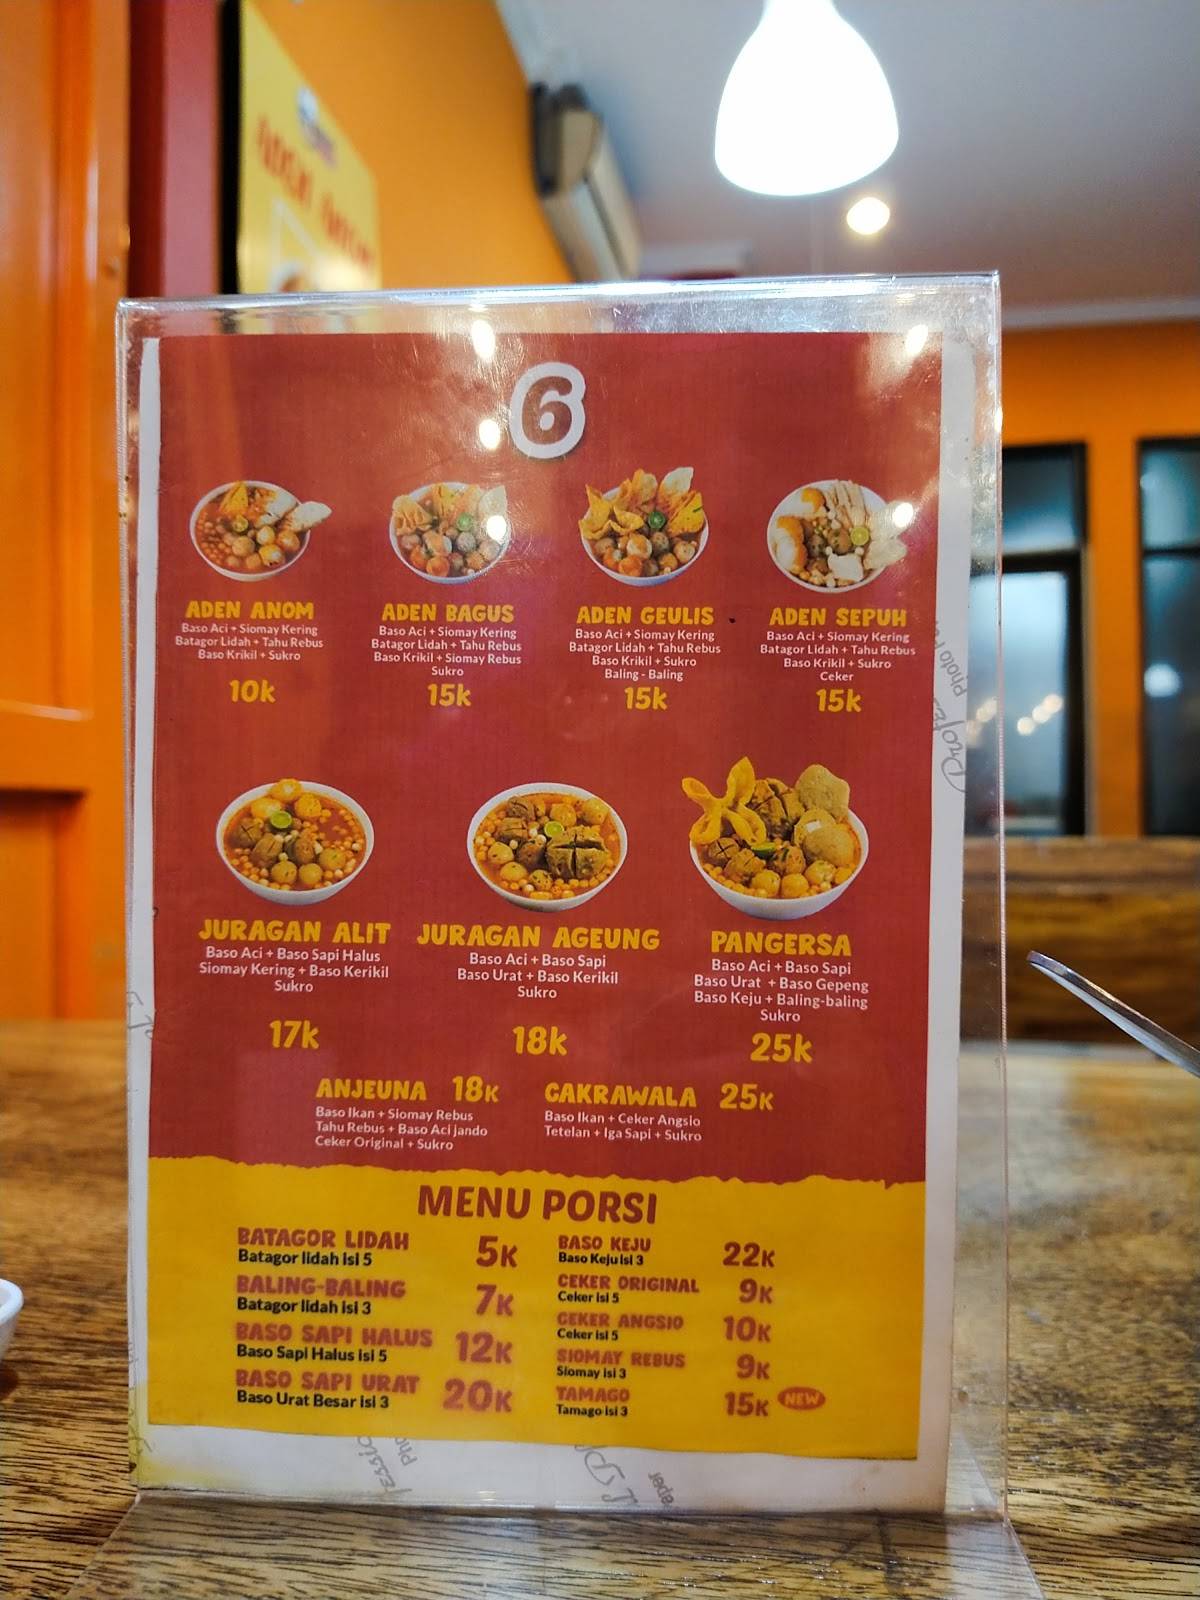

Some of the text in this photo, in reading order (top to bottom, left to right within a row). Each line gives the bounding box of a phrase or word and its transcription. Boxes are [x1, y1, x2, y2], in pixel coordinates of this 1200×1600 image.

[509, 362, 586, 459] 6
[185, 600, 314, 620] ADEN ANOM
[382, 603, 514, 623] ADEN BAGUS
[576, 606, 714, 625] ADEN GEULIS
[769, 607, 907, 627] ADEN SEPUH
[182, 623, 318, 636] Baso Aci Siomay Kering
[379, 626, 517, 639] Baso Aci Siomay Kering
[575, 629, 715, 642] Baso Aci Siomay Kering
[767, 631, 910, 644] Baso Aci Siomay Kering
[371, 639, 522, 651] Batagor Lidah Tahu Rebus
[374, 652, 522, 665] Baso Krikil Siomay Rebus
[592, 656, 697, 667] Baso Krikil Sukro
[431, 666, 464, 676] Sukro
[605, 669, 683, 681] Baling Baling
[820, 672, 854, 681] Ceker
[229, 679, 276, 703] 10k
[428, 683, 472, 707] 15k
[624, 686, 668, 710] 15k
[816, 688, 862, 712] 15k
[198, 919, 392, 944] JURAGAN ALIT
[417, 924, 660, 950] JURAGAN AGEUNG
[711, 931, 852, 956] PANGERSA
[206, 947, 381, 963] Baso Aci Baso Sapi Halus
[469, 953, 607, 970] Baso Aci Baso Sapi
[200, 963, 389, 978] Siomay Kering Baso Kerikil
[457, 969, 619, 984] Baso Urat Baso Kerikil
[712, 959, 851, 977] Baso Aci Baso Sapi
[274, 980, 314, 992] Sukro
[517, 986, 558, 999] Sukro
[694, 975, 869, 994] Baso Urat Baso Gepeng
[694, 991, 868, 1009] Baso Keju Baling-baling
[760, 1009, 801, 1023] Sukro
[269, 1020, 320, 1049] 17k
[512, 1026, 568, 1056] 18k
[750, 1032, 813, 1063] 25k
[316, 1075, 499, 1103] ANJEUNA 18K
[544, 1082, 774, 1111] CAKRAWALA 25K
[315, 1107, 473, 1122] Baso Ikan Siomay Rebus
[545, 1111, 701, 1127] Baso Ikan Ceker Angsio
[545, 1125, 702, 1141] Tetelan Iga Sapi Sukro
[315, 1136, 454, 1150] Ceker Original Sukro
[418, 1185, 657, 1224] MENU PORSI
[237, 1227, 409, 1250] BATAGOR LIDAH
[558, 1234, 652, 1252] BASO KEJU
[238, 1248, 372, 1266] Batagor lidah isi 5
[476, 1235, 518, 1268] 5K
[723, 1241, 775, 1268] 22K
[237, 1275, 406, 1298] BALING-BALING
[558, 1273, 700, 1293] CEKER ORIGINAL
[739, 1278, 773, 1304] 9K
[476, 1284, 513, 1317] 7K
[558, 1291, 619, 1303] Ceker isi 5
[557, 1311, 684, 1330] CEKER ANGSIO
[723, 1315, 771, 1342] 10K
[236, 1322, 433, 1348] BASO SAPI HALUS
[237, 1344, 387, 1362] Baso Sapi Halus isi 5
[456, 1331, 513, 1364] 12K
[557, 1348, 686, 1368] SIOMAY REBUS
[736, 1354, 770, 1380] 9K
[236, 1369, 420, 1394] BASO SAPI URAT
[237, 1390, 388, 1409] Baso Urat Besar isi 3
[443, 1378, 512, 1412] 20K
[556, 1386, 630, 1403] TAMAGO
[785, 1392, 820, 1405] NEW
[725, 1392, 769, 1417] 15K
